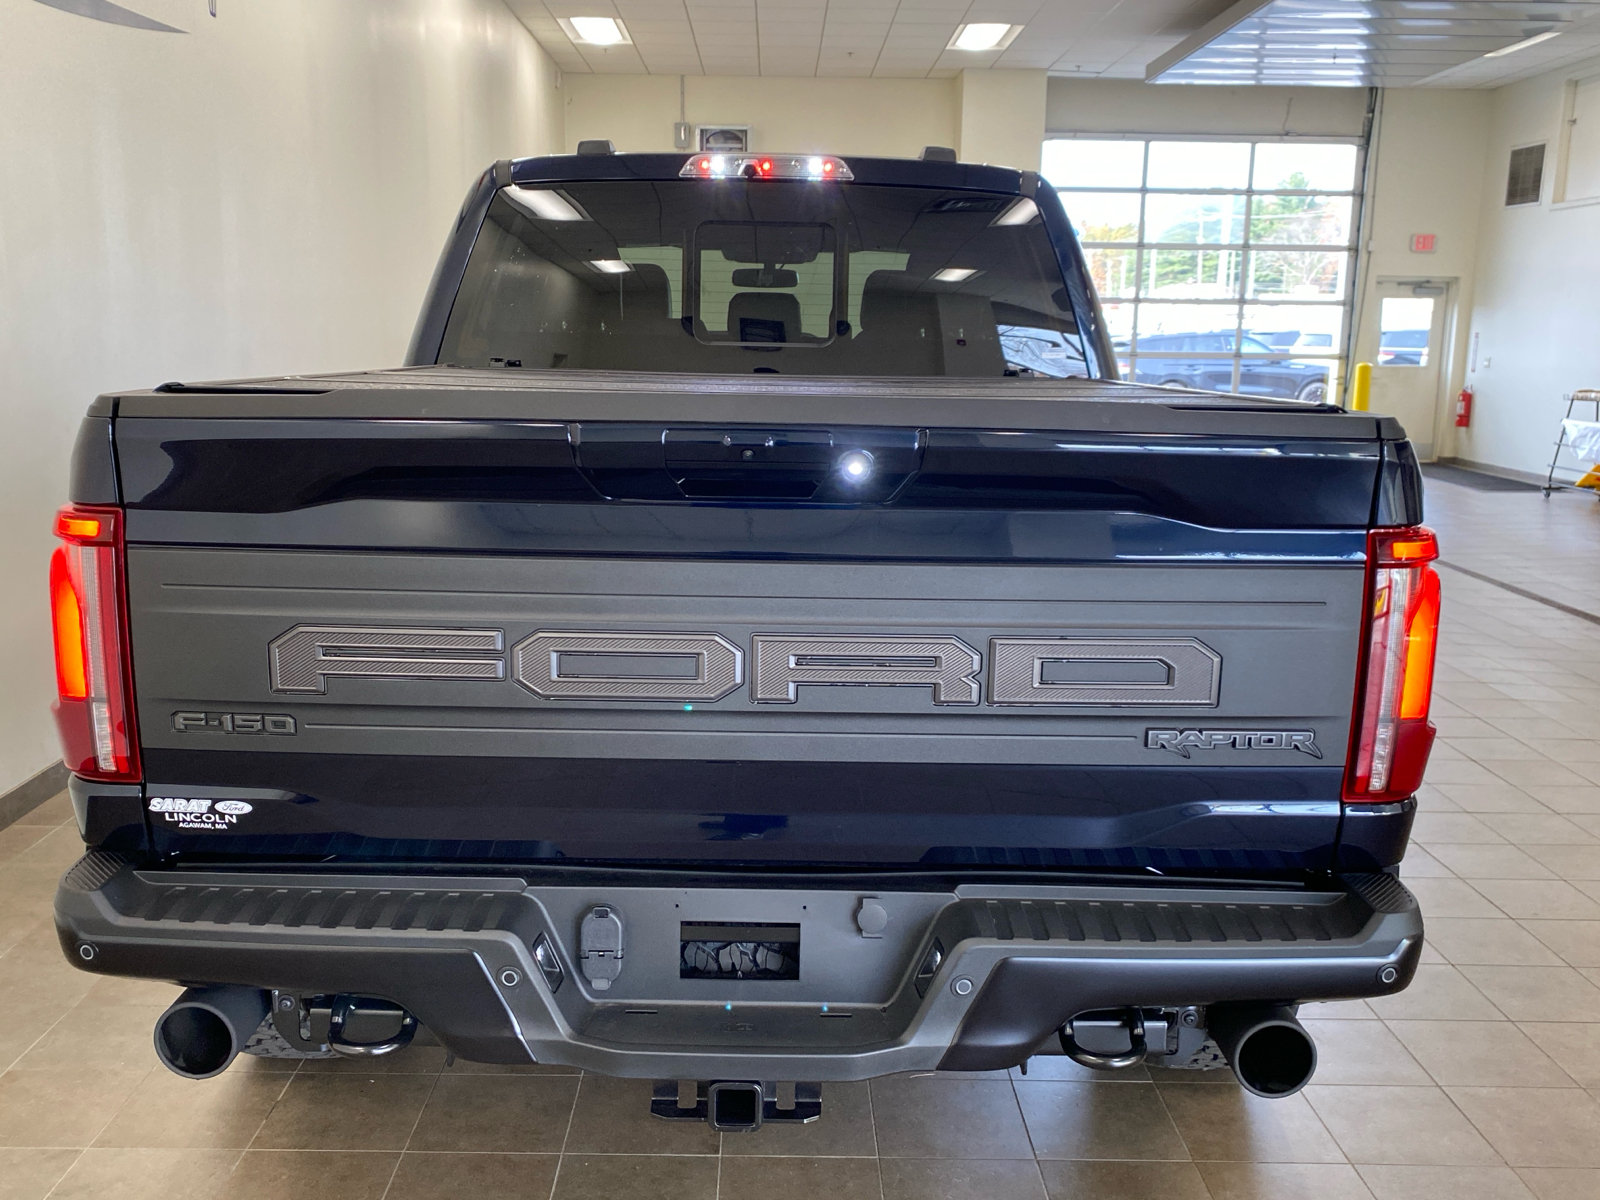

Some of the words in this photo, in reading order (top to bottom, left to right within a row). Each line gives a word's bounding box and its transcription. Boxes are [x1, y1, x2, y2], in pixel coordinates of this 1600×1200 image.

[269, 623, 1221, 706] FORD
[171, 711, 297, 735] F-150
[1145, 728, 1322, 759] RAPTOR
[149, 798, 211, 813] SARAT
[221, 802, 245, 812] Ford
[164, 812, 237, 823] LINCOLN
